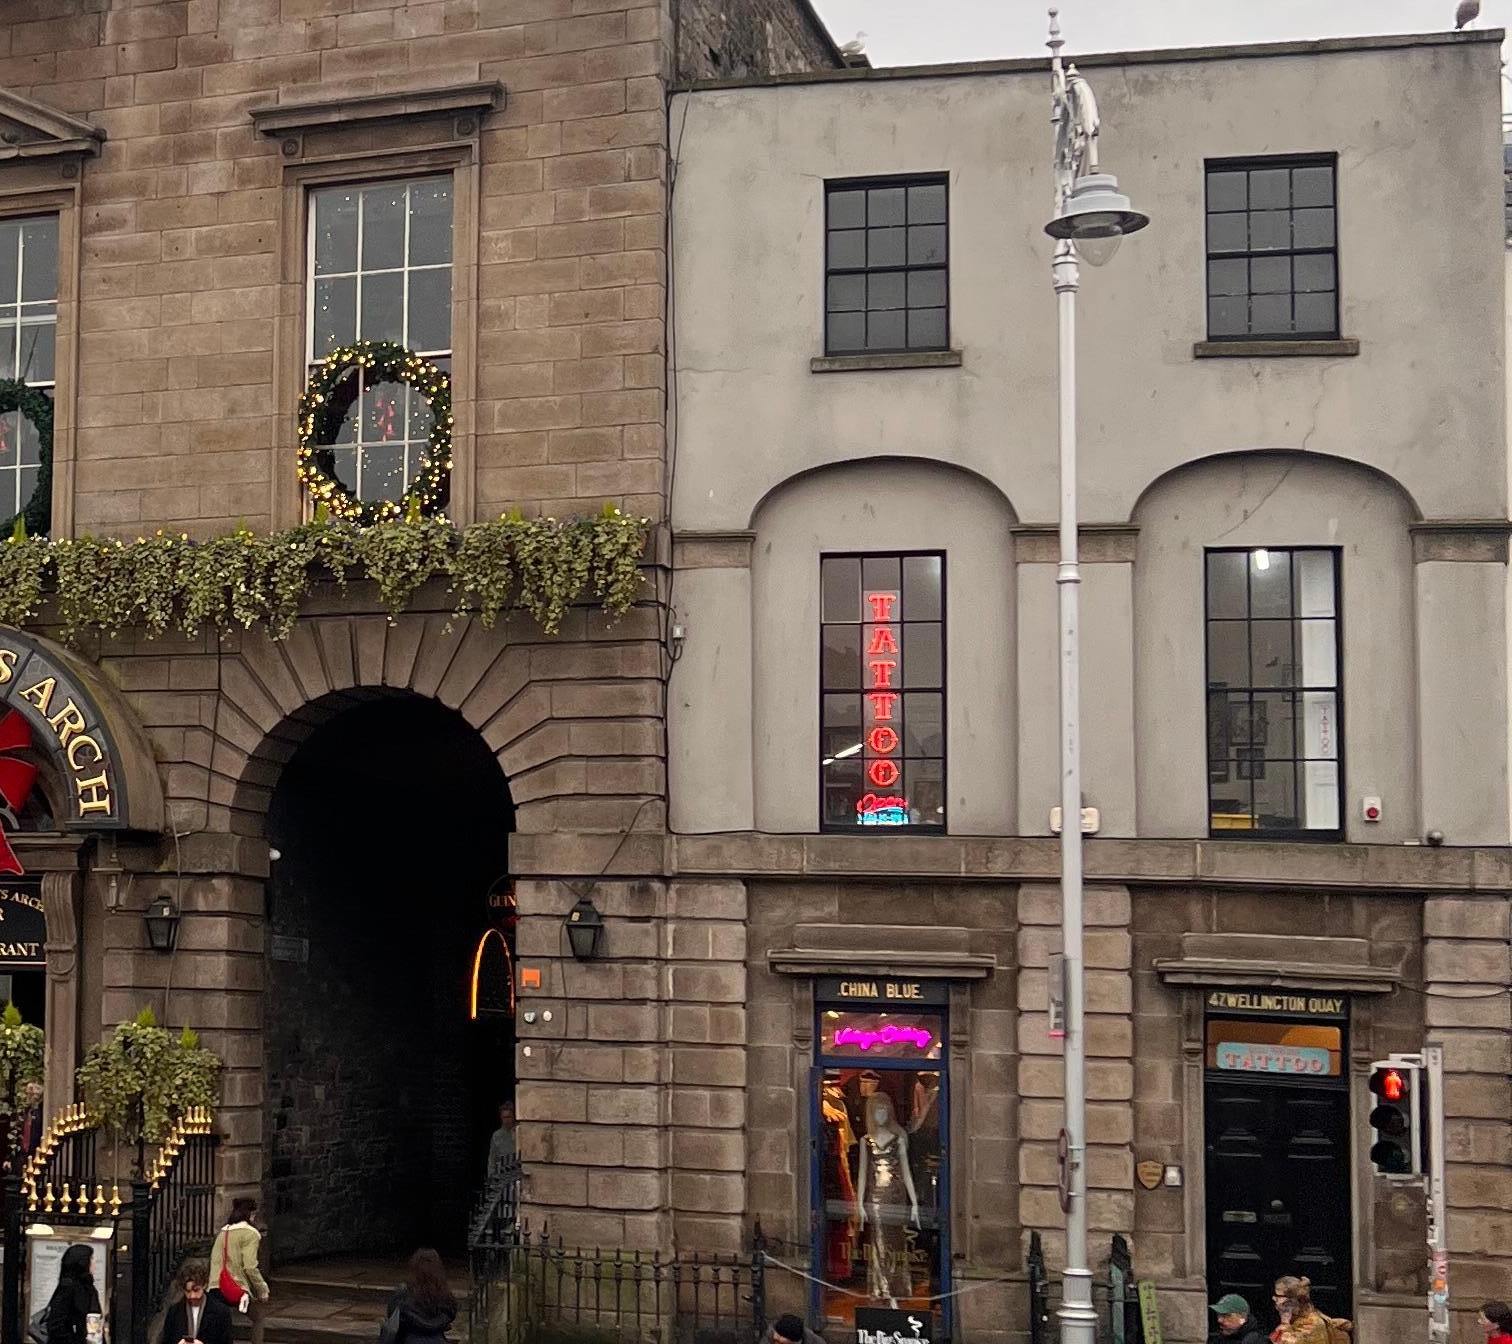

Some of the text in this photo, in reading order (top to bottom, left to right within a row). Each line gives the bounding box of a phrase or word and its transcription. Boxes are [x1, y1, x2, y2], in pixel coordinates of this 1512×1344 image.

[867, 593, 899, 787] TATTOO
[19, 676, 113, 818] ARCH
[840, 981, 878, 997] CHINA
[1228, 993, 1306, 1011] WELLINGTON
[1308, 998, 1343, 1013] QUAY
[1225, 1053, 1322, 1072] TATTOO
